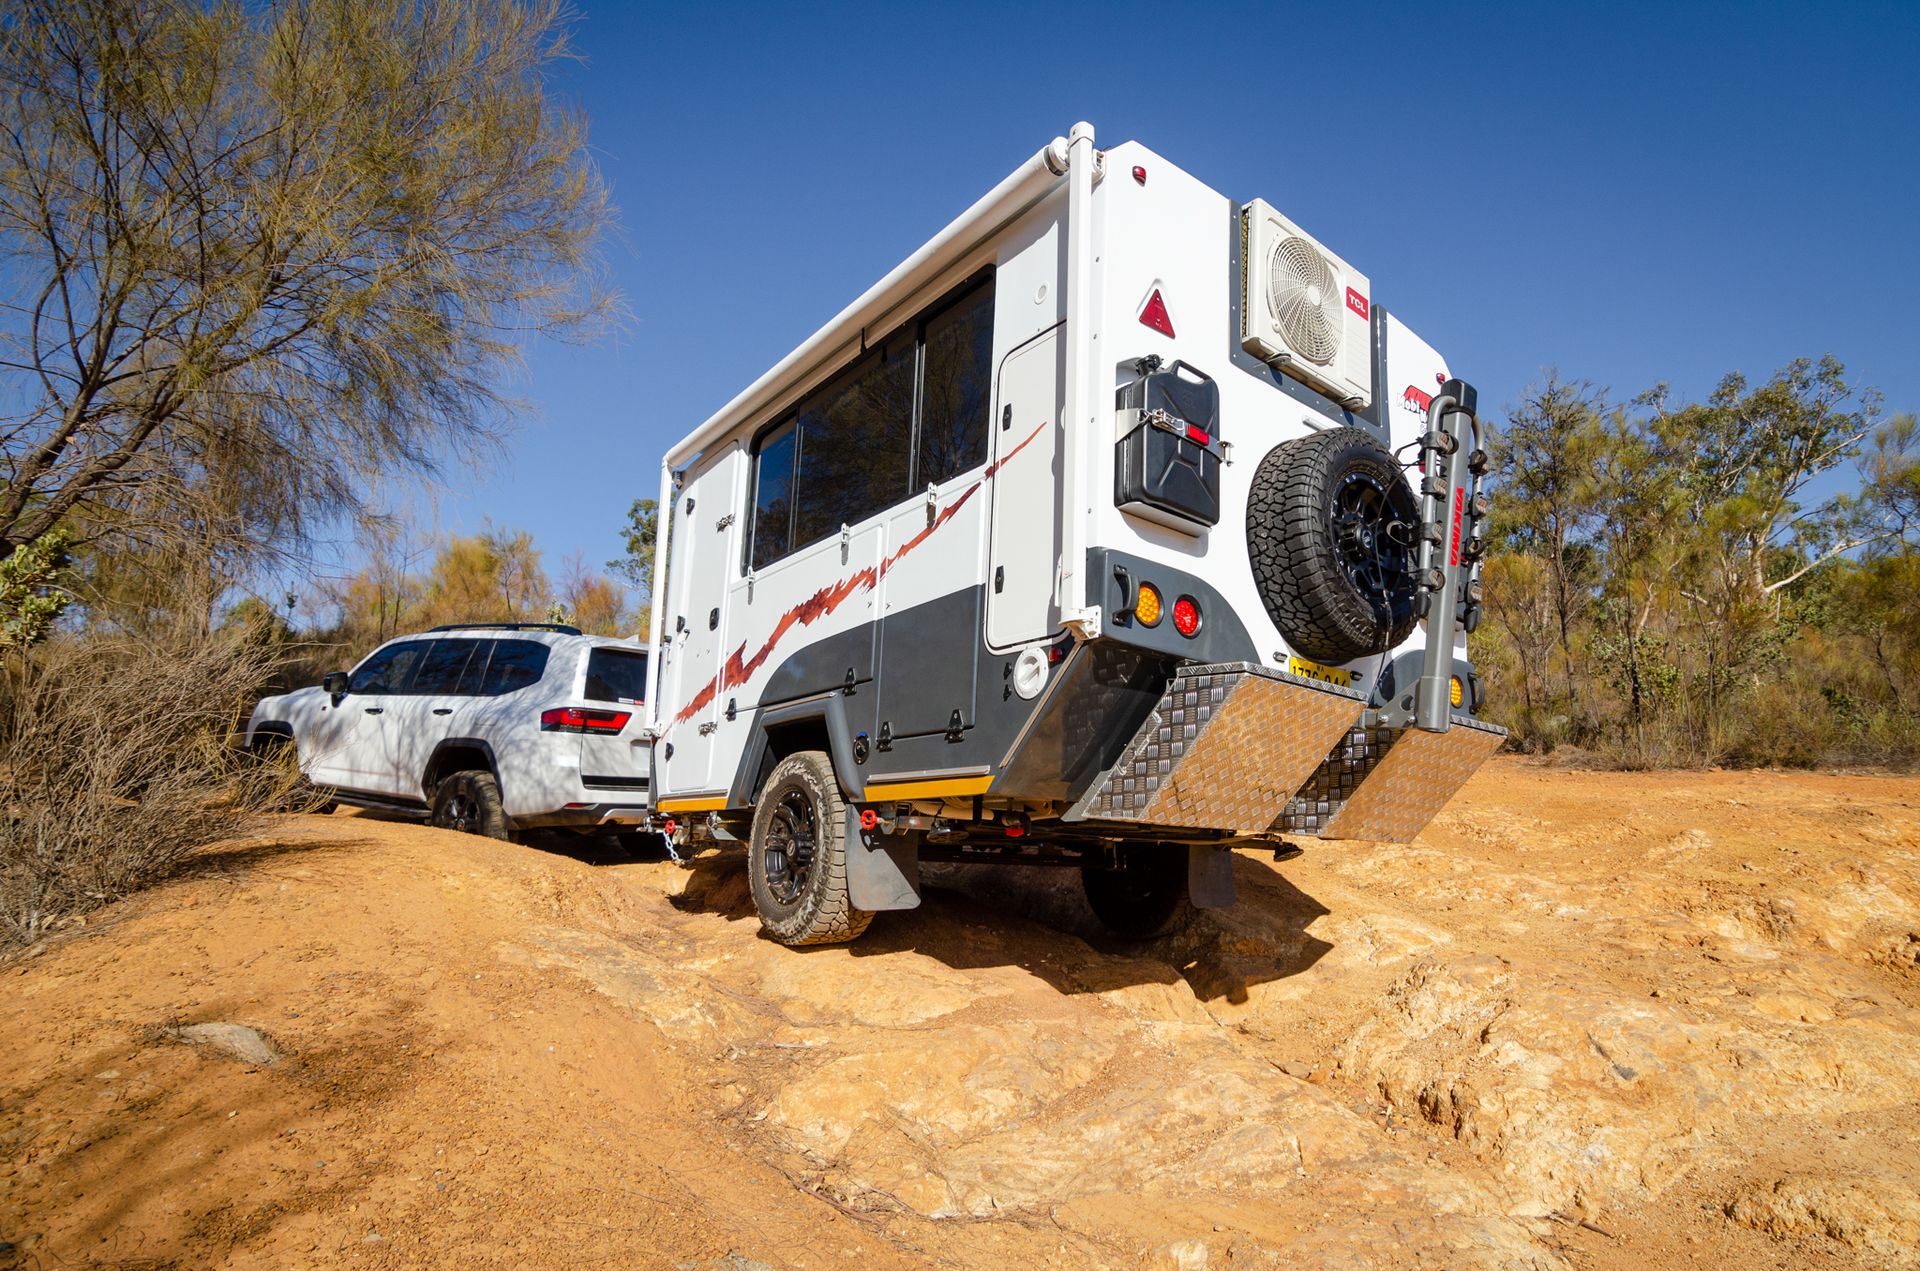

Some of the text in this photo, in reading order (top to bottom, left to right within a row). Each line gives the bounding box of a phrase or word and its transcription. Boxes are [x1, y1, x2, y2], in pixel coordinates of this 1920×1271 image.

[1349, 293, 1366, 313] TCL
[1396, 392, 1420, 414] Mobi
[1450, 487, 1464, 567] YAKIMA
